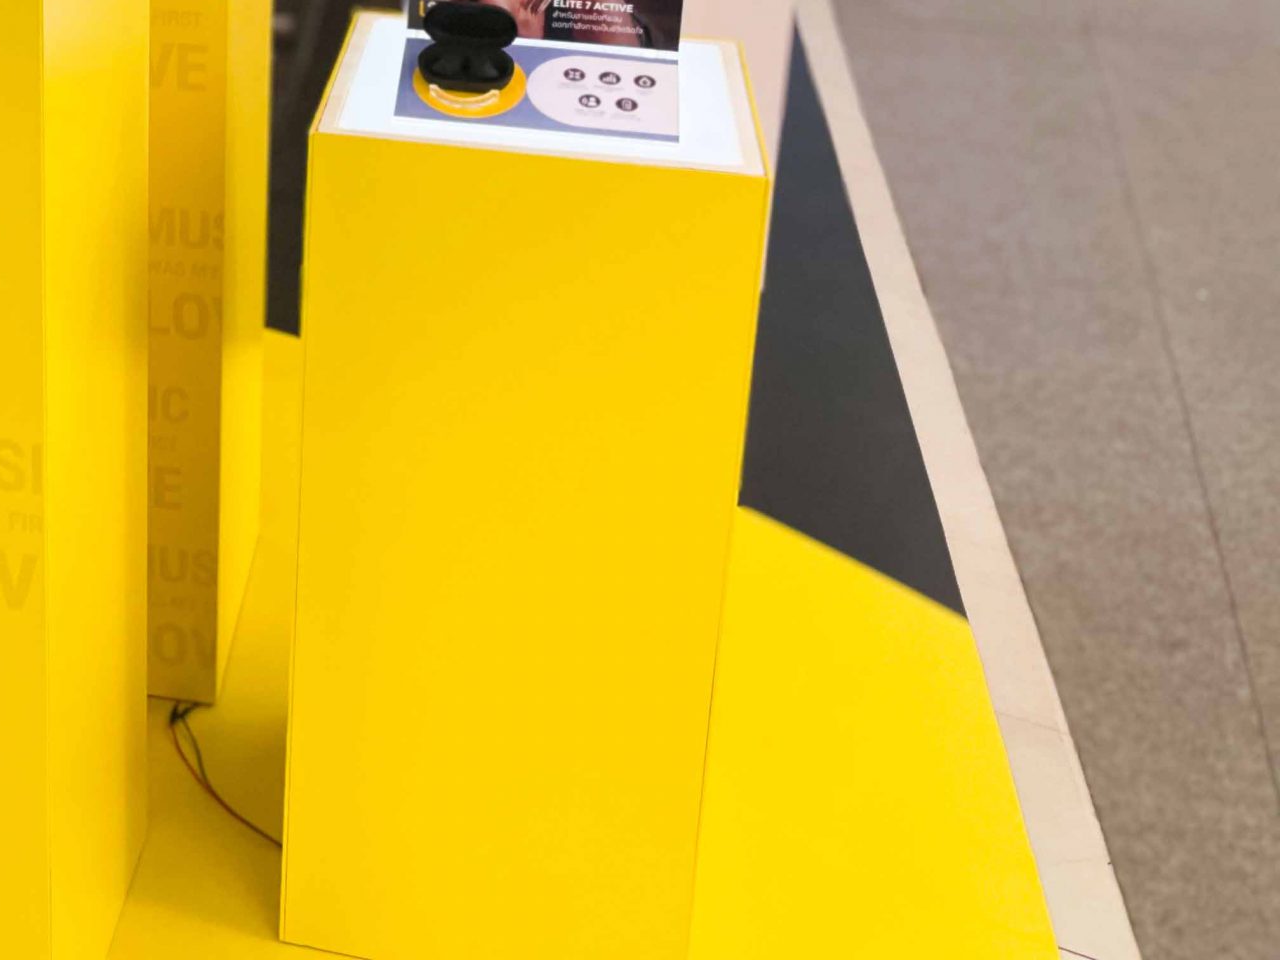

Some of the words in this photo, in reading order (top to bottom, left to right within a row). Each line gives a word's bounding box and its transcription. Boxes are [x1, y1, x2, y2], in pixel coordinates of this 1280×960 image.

[553, 0, 583, 9] ELITE
[585, 1, 592, 10] 7
[593, 2, 634, 13] ACTIVE
[8, 512, 42, 535] FIR
